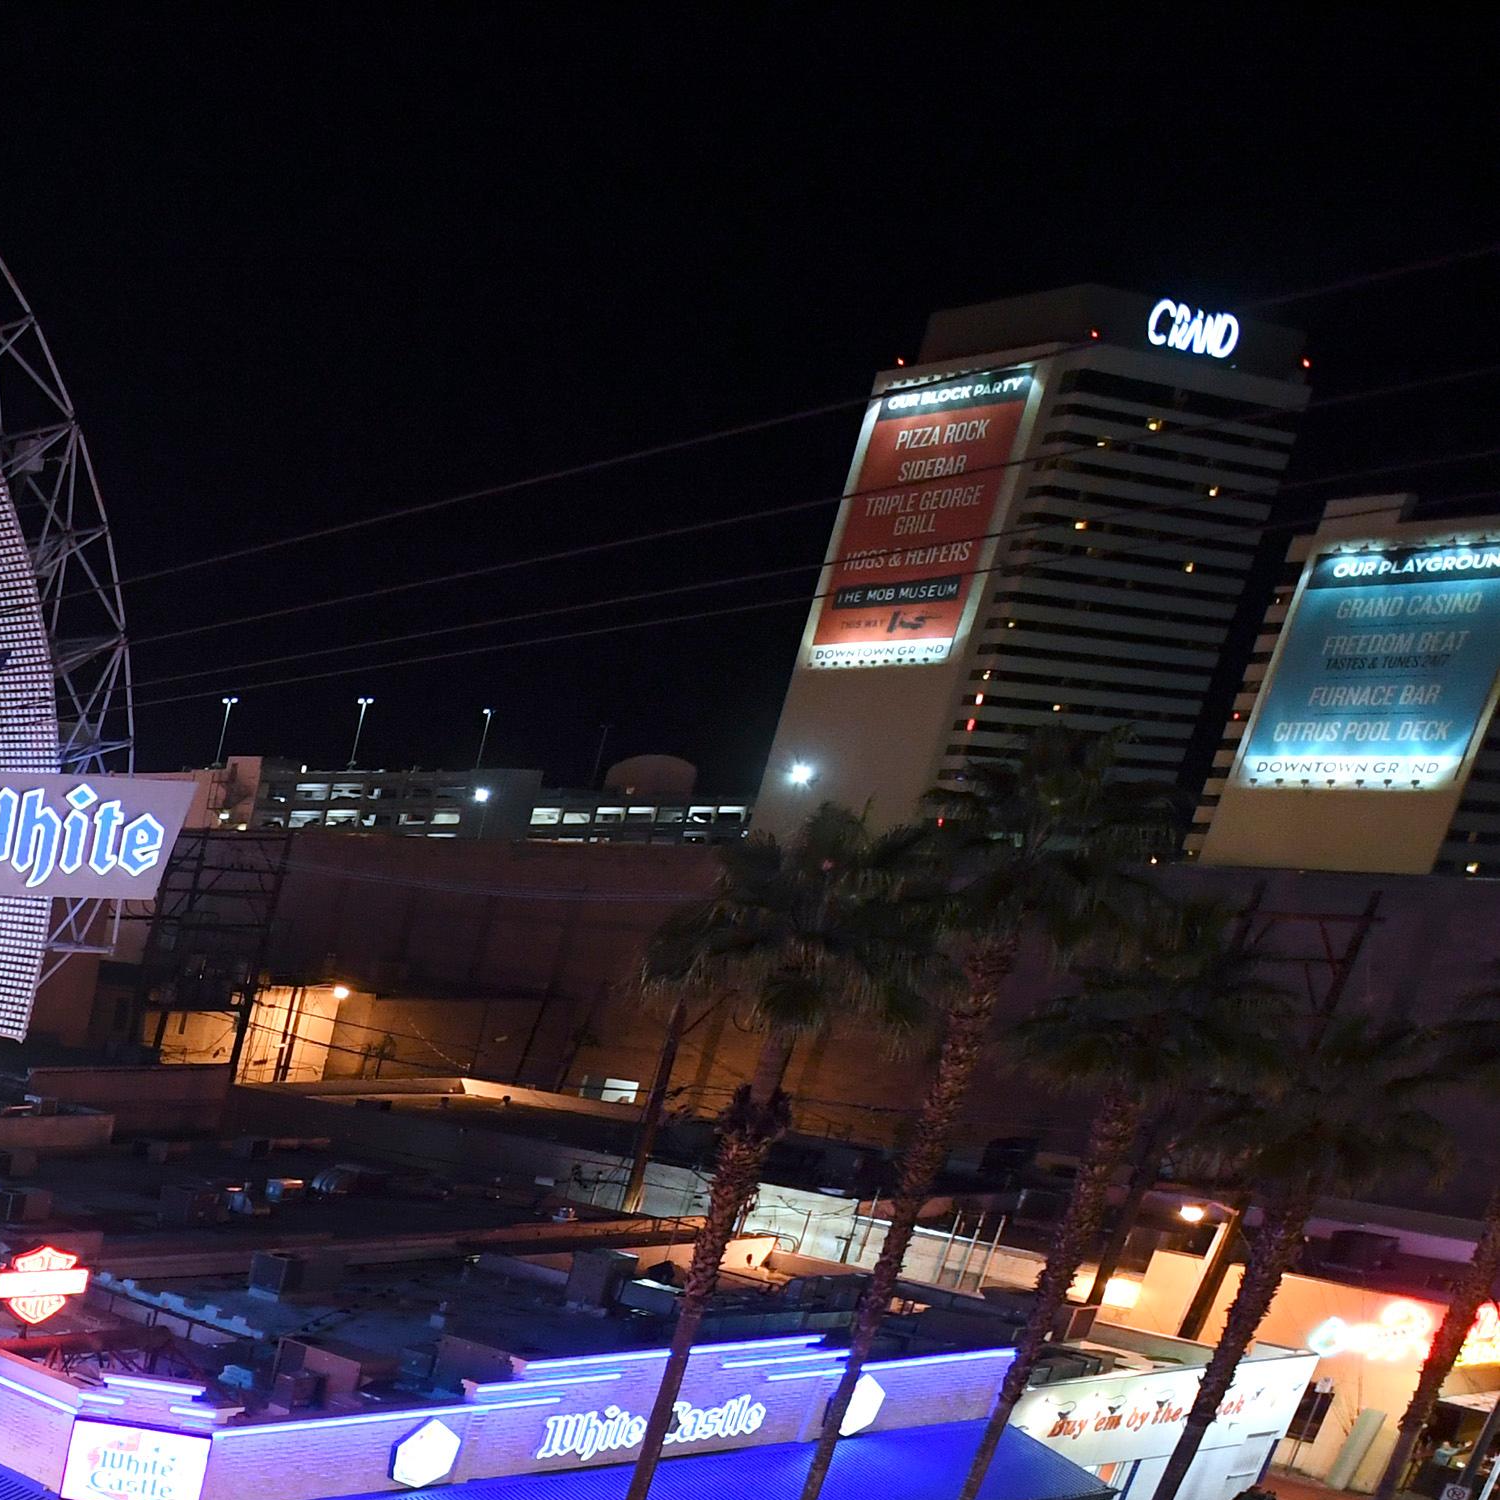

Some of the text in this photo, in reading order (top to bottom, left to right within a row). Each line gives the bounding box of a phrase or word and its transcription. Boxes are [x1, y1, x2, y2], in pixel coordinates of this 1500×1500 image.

[888, 376, 1025, 410] OUR BLOCK PARTY
[896, 418, 991, 450] PIZZA ROCK
[898, 455, 967, 482] SIDEBAR
[865, 484, 985, 517] TRIPLE GEORGE
[893, 513, 936, 536] GRILL
[888, 548, 902, 567] &
[906, 541, 973, 566] HEIFERS
[1333, 561, 1376, 578] OUR
[838, 582, 957, 604] THE MOB MUSEUM
[1336, 592, 1483, 620] GRAND CASINO
[815, 644, 944, 660] DOWNTOWN GRND
[1322, 630, 1470, 656] FREEDOM BEAT
[1325, 657, 1366, 671] TASTES
[1367, 656, 1376, 670] &
[1382, 655, 1418, 669] TUNES
[1308, 683, 1441, 708] FURNACE BAR
[1273, 720, 1452, 743] CITRUS POOL DECK
[1256, 760, 1439, 775] DOWNTOWN GRND
[535, 1404, 649, 1462] White
[1047, 1416, 1087, 1440] Buy
[1126, 1406, 1150, 1433] by
[1151, 1402, 1184, 1426] the
[99, 1448, 177, 1478] White
[90, 1470, 174, 1499] Castle
